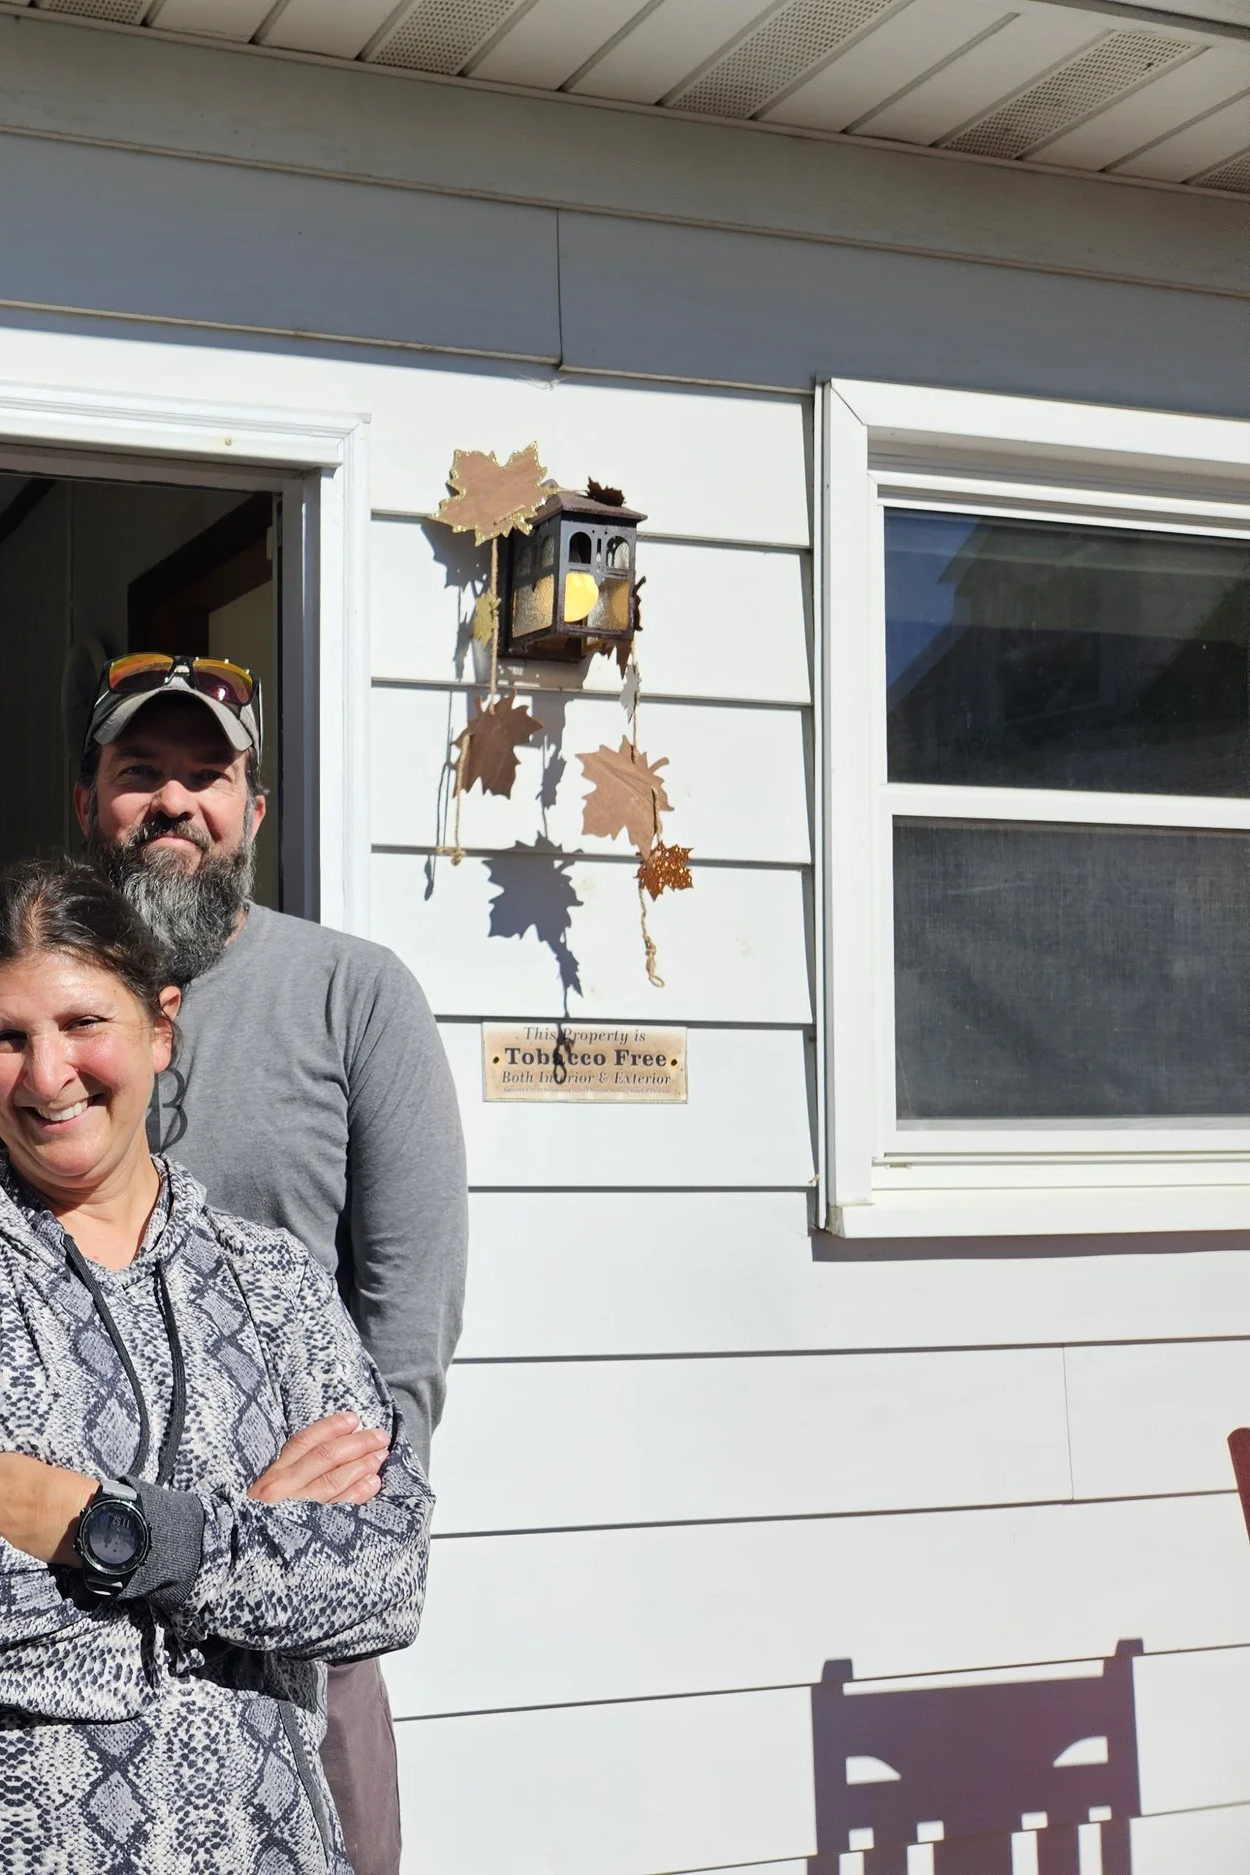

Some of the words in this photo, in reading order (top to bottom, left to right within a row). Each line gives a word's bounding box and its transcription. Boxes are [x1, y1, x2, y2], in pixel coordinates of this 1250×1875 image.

[524, 1027, 556, 1040] This
[562, 1028, 629, 1045] Property
[634, 1029, 647, 1042] is
[614, 1049, 667, 1067] Free
[502, 1071, 533, 1083] Both
[539, 1071, 594, 1084] Inrior
[599, 1072, 608, 1084] &
[614, 1072, 671, 1085] Exterior
